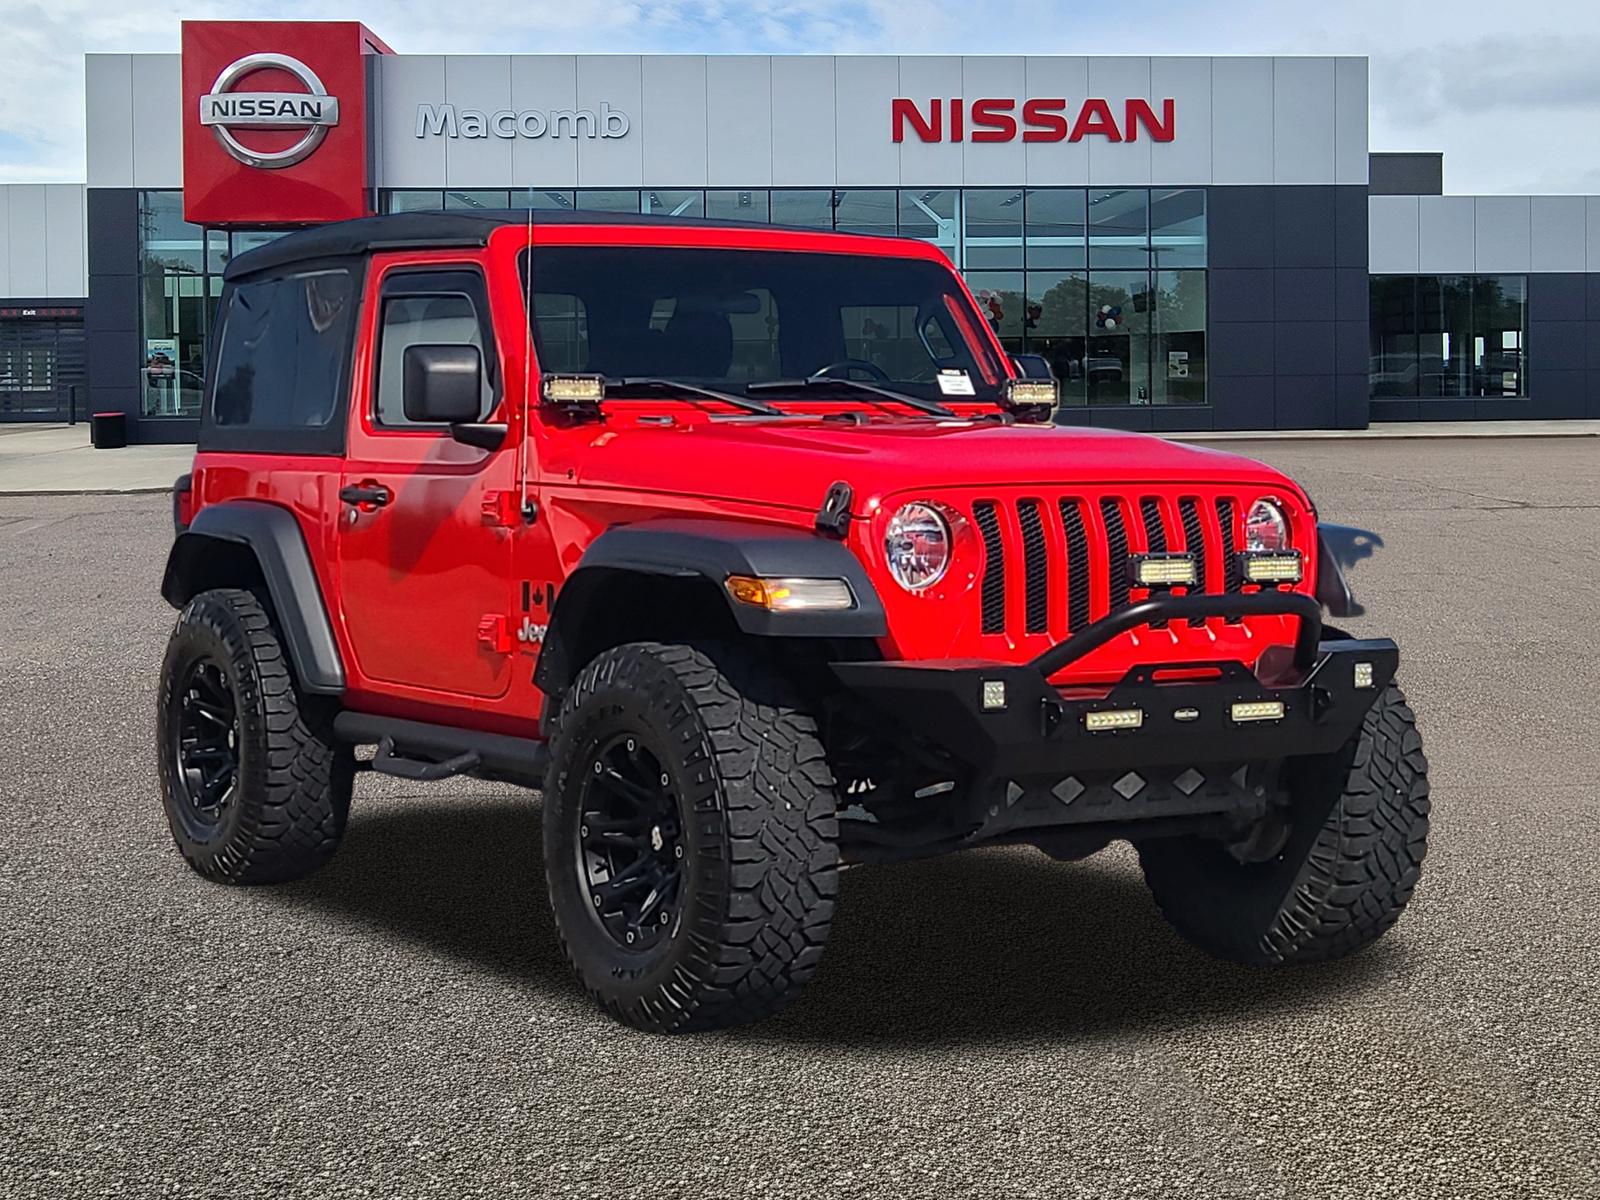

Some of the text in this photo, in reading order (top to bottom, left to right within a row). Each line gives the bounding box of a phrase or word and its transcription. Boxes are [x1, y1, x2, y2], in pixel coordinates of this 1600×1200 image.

[211, 99, 323, 118] NISSAN
[415, 102, 631, 139] Macomb
[891, 98, 1176, 143] NISSAN
[517, 616, 548, 643] Jee
